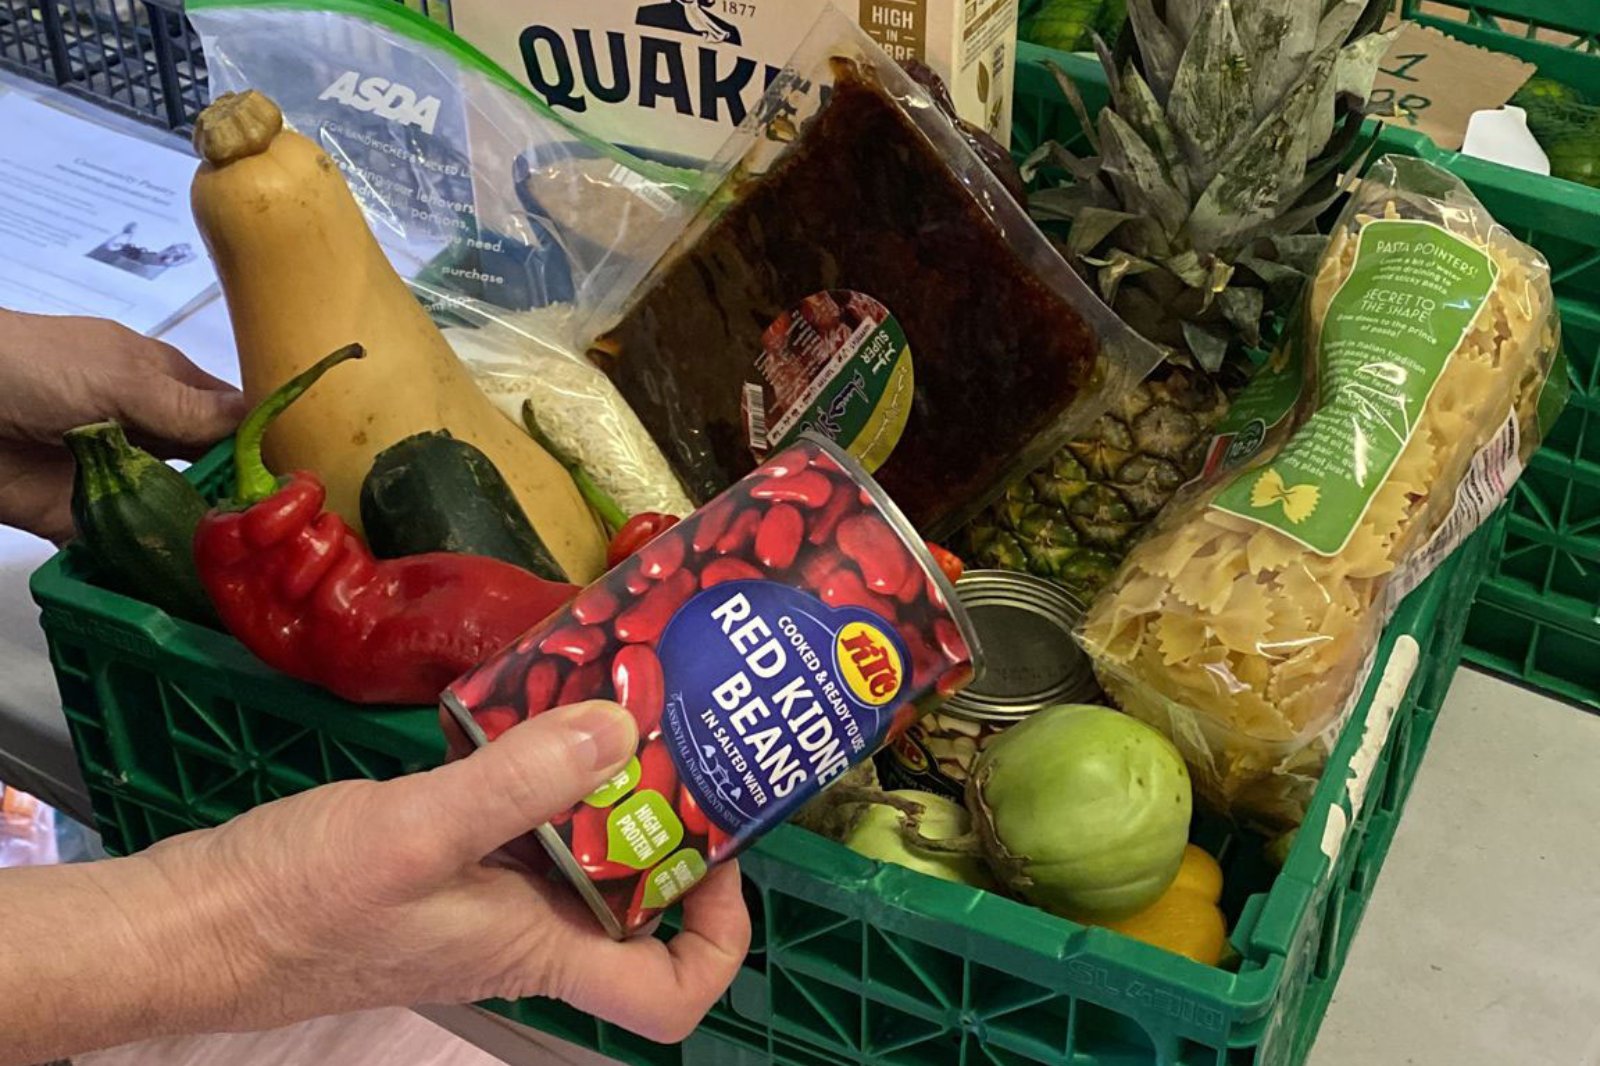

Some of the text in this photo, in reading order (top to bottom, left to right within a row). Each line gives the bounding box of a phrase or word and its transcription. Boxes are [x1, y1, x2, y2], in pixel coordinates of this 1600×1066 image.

[722, 1, 757, 18] 1877
[871, 5, 914, 30] HIGH
[878, 43, 916, 61] BRE
[885, 29, 899, 42] IN
[518, 24, 835, 134] QUAK
[318, 71, 442, 135] ASDA
[441, 266, 504, 285] purchase
[1376, 241, 1479, 279] PASTA POINTERS!
[1360, 300, 1430, 323] THE SHAPE
[1363, 288, 1436, 311] SECRET TO
[860, 330, 890, 364] SUPER
[1391, 319, 1408, 330] the
[1407, 326, 1438, 345] prince
[1388, 350, 1426, 376] tradition
[710, 592, 851, 792] RED KIDNE
[777, 615, 866, 754] COOKED & READY TO USE
[666, 703, 690, 760] ESSENTIAL
[711, 671, 808, 799] BEANS
[700, 708, 768, 808] IN SALTED WATER
[615, 813, 655, 862] PROTEIN
[634, 803, 670, 848] HIGH IN
